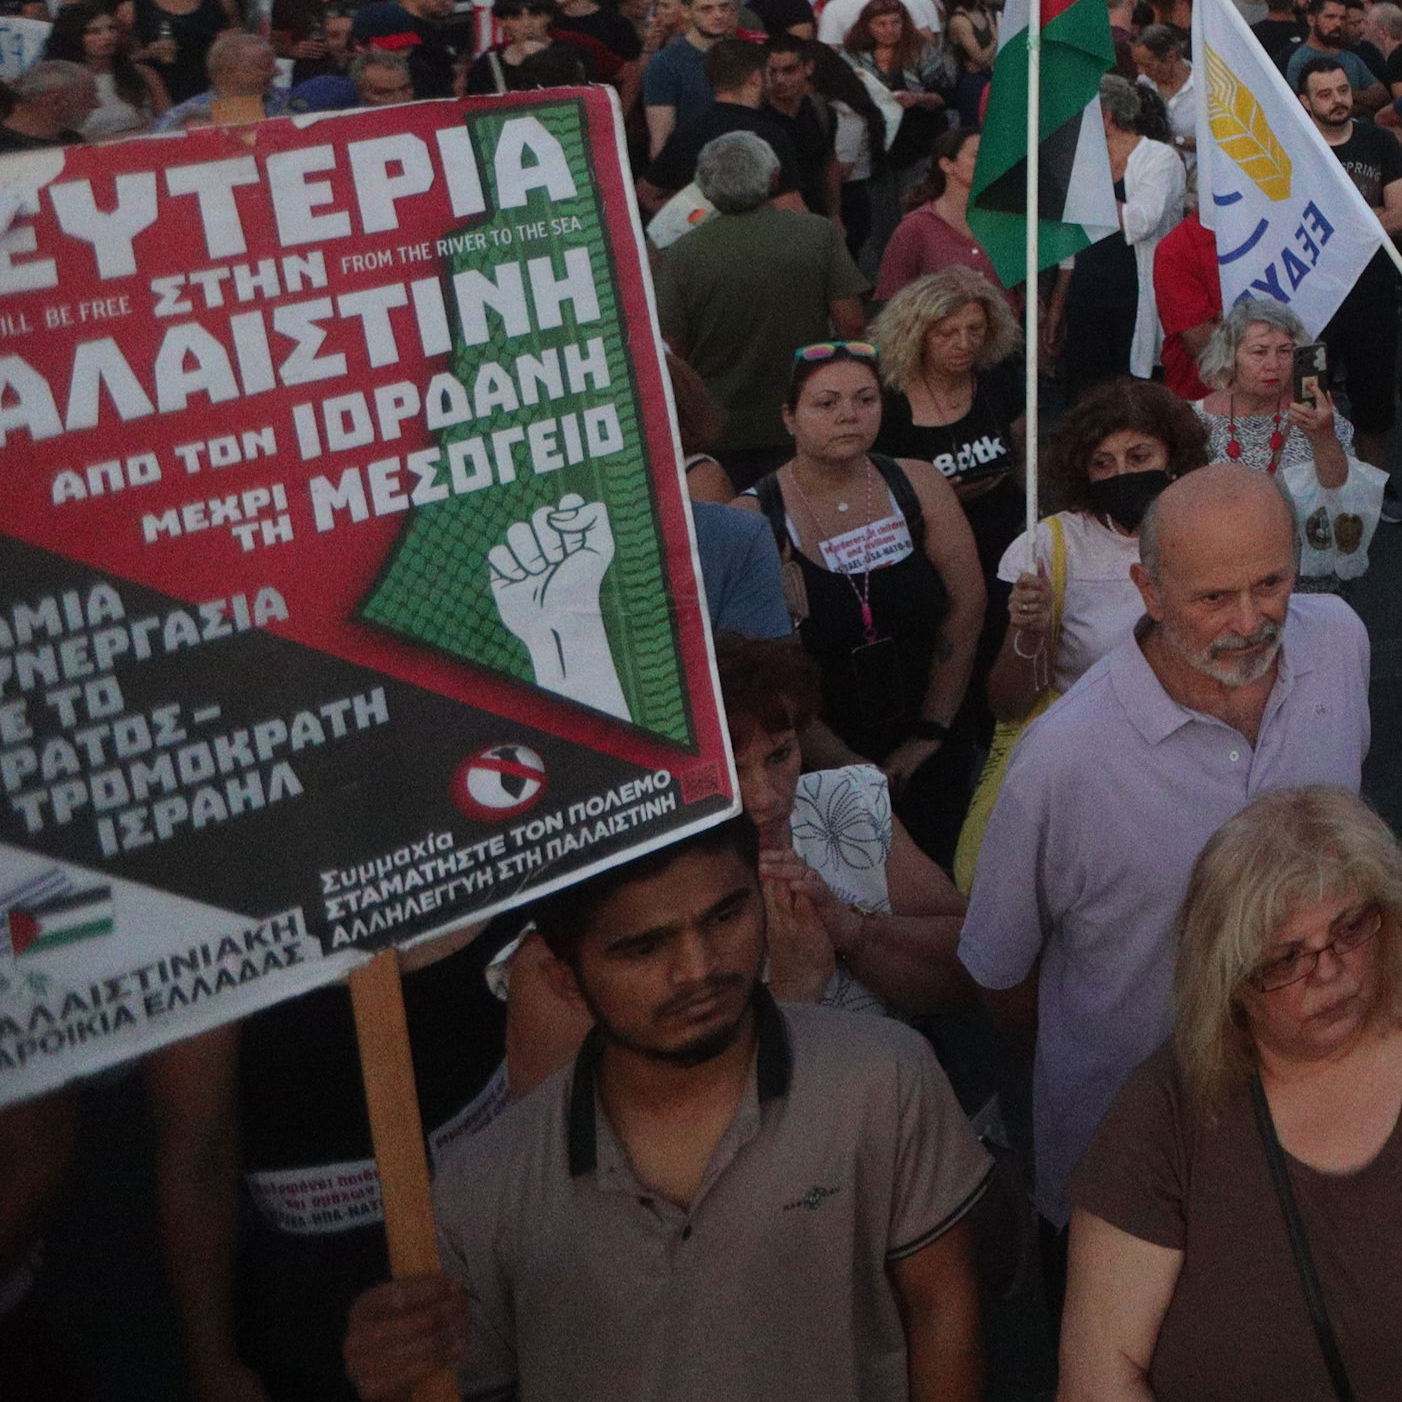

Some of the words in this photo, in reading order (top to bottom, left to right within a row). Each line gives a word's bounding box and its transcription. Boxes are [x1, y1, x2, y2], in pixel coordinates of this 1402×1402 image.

[0, 115, 578, 294] ΕΥΤΕΡΙΑ
[341, 249, 393, 275] FROM
[397, 241, 433, 265] THE
[435, 233, 488, 258] RIVER
[490, 228, 513, 246] TO
[516, 220, 549, 243] THE
[551, 215, 583, 235] SEA
[0, 312, 35, 337] ILL
[45, 303, 75, 330] BE
[79, 295, 134, 323] FREE
[150, 250, 329, 319] ΣΤΗΝ
[0, 247, 602, 448] ΑΛΑΙΣΤΙΝΗ
[50, 452, 163, 505] ΑΠΟ
[175, 427, 279, 476] ΤΟΝ
[291, 337, 612, 461] ΙΟΡΔΑΝΗ
[141, 483, 289, 544] ΜΕΧΡΙ
[309, 403, 625, 533] ΜΕΣΟΓΕΙΟ
[231, 515, 296, 554] ΤΗ
[0, 699, 34, 744] Ε
[46, 675, 126, 728] ΤΟ
[12, 686, 391, 836] ΤΡΟΜΟΚΡΑΤΗ
[100, 760, 305, 858] ΙΣΡΑΗΛ
[320, 830, 454, 895] Συμμαχία
[325, 832, 507, 921] ΣΤΑΜΑΤΗΣΤΕ
[510, 810, 565, 848] ΤΟΝ
[569, 769, 672, 827] ΠΟΛΕΜΟ
[331, 866, 494, 949] ΑΛΛΗΛΕΓΓΥΗ
[499, 849, 543, 882] ΣΤΗ
[547, 792, 677, 863] ΠΑΛΑΙΣΤΙΝΗ
[0, 914, 300, 1036] ΑΛΑΙΣΤΙΝΙΑΚΗ
[143, 943, 306, 1019] ΕΛΛΑΔΑΣ
